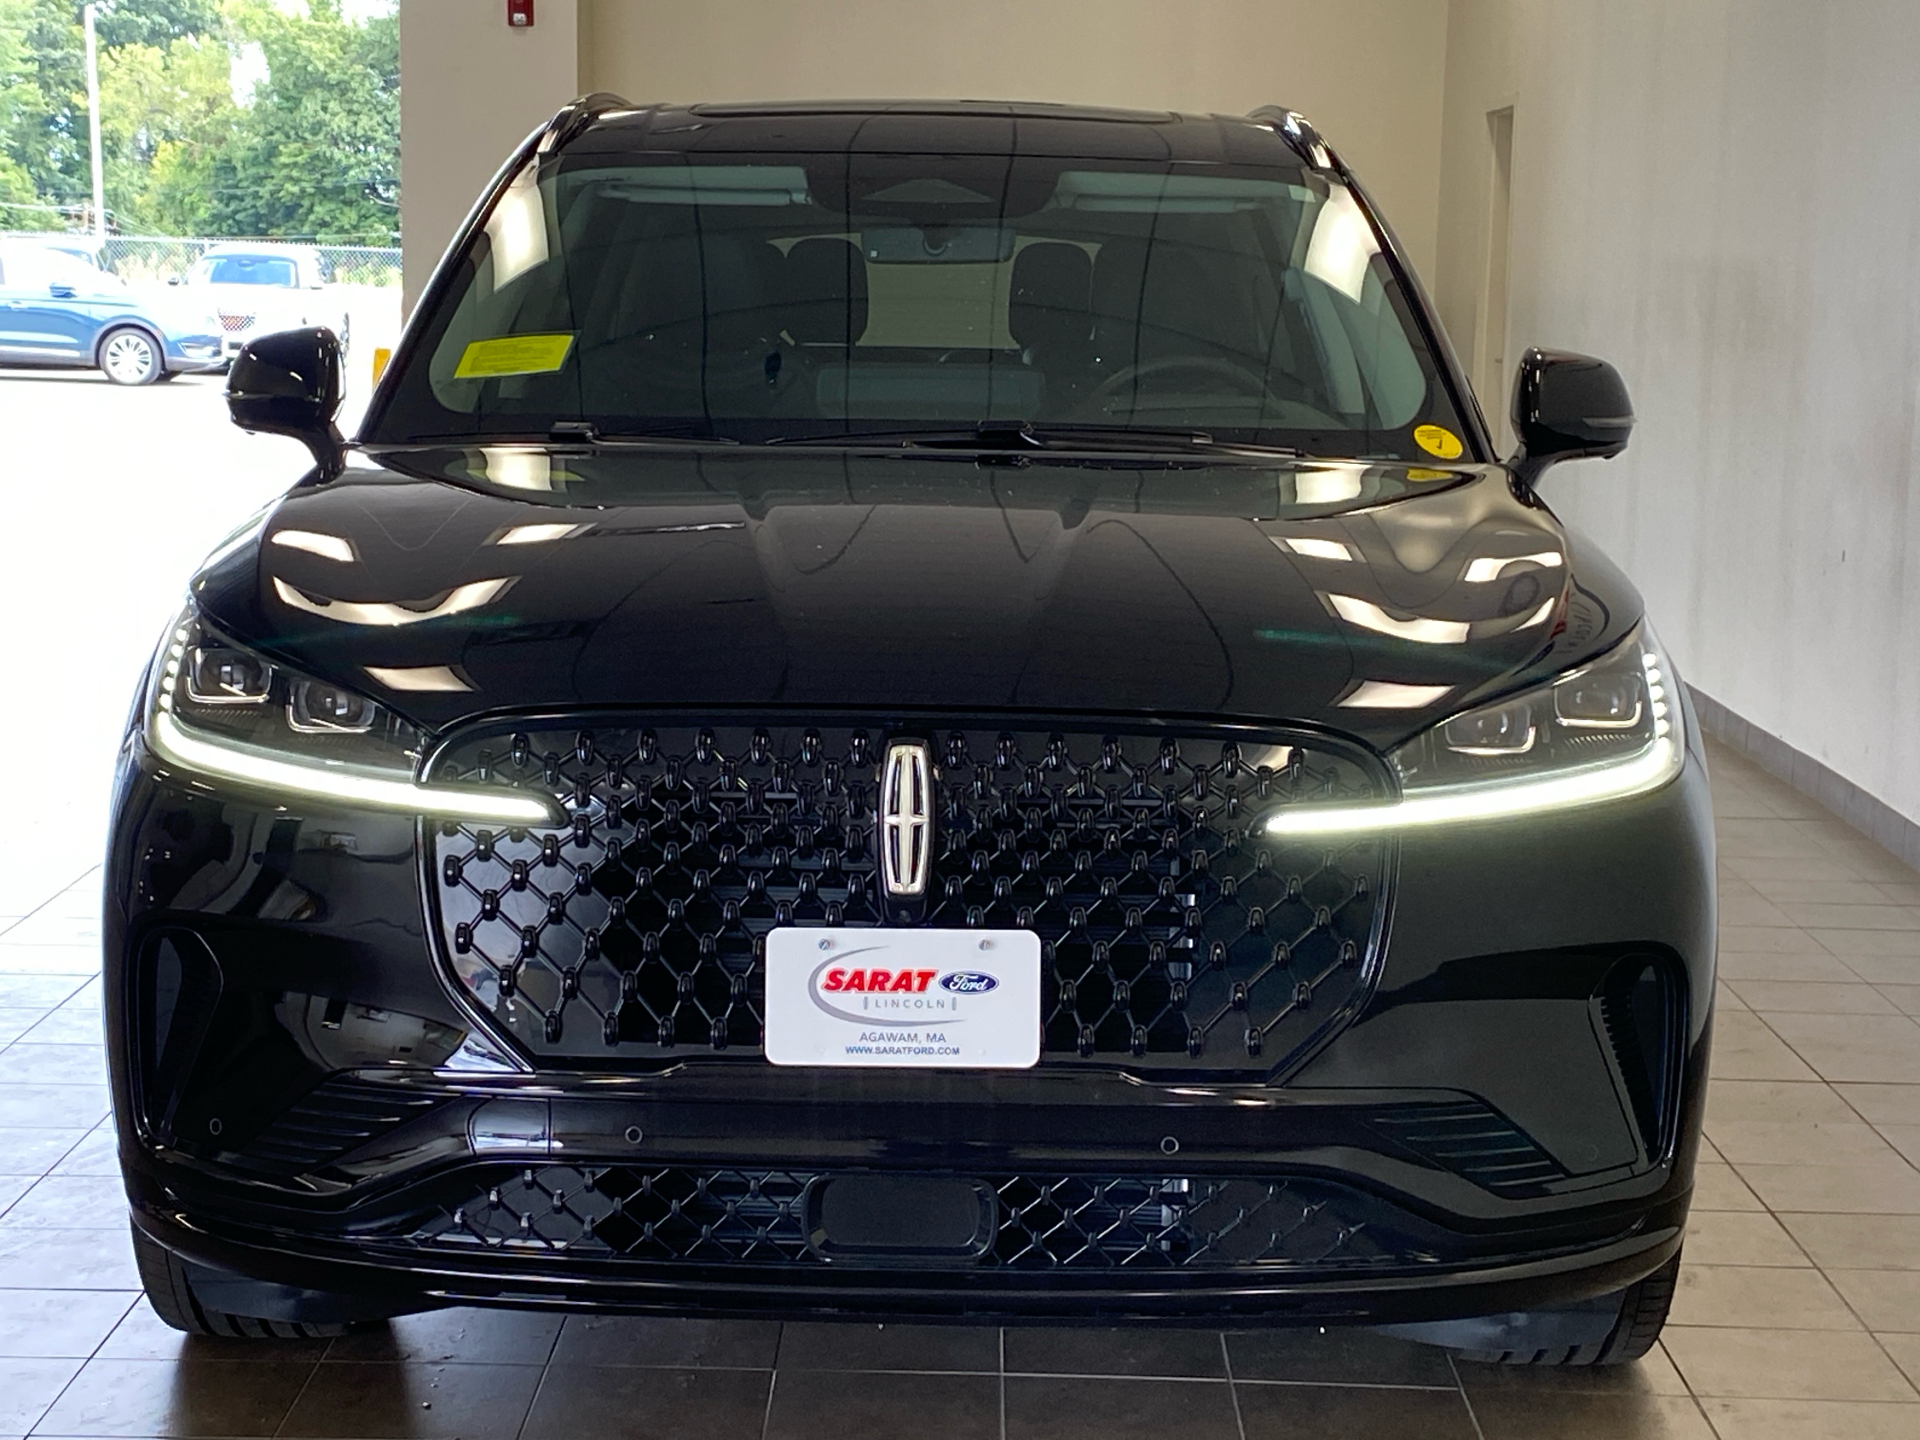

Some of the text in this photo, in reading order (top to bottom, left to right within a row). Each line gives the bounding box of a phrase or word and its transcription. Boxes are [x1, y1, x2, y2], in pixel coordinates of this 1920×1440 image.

[821, 968, 988, 994] SARAT Ford
[875, 999, 945, 1009] LINCOLN
[859, 1032, 946, 1044] AGAWAM, MA
[845, 1046, 960, 1056] WWW.SARATFORD.COM
